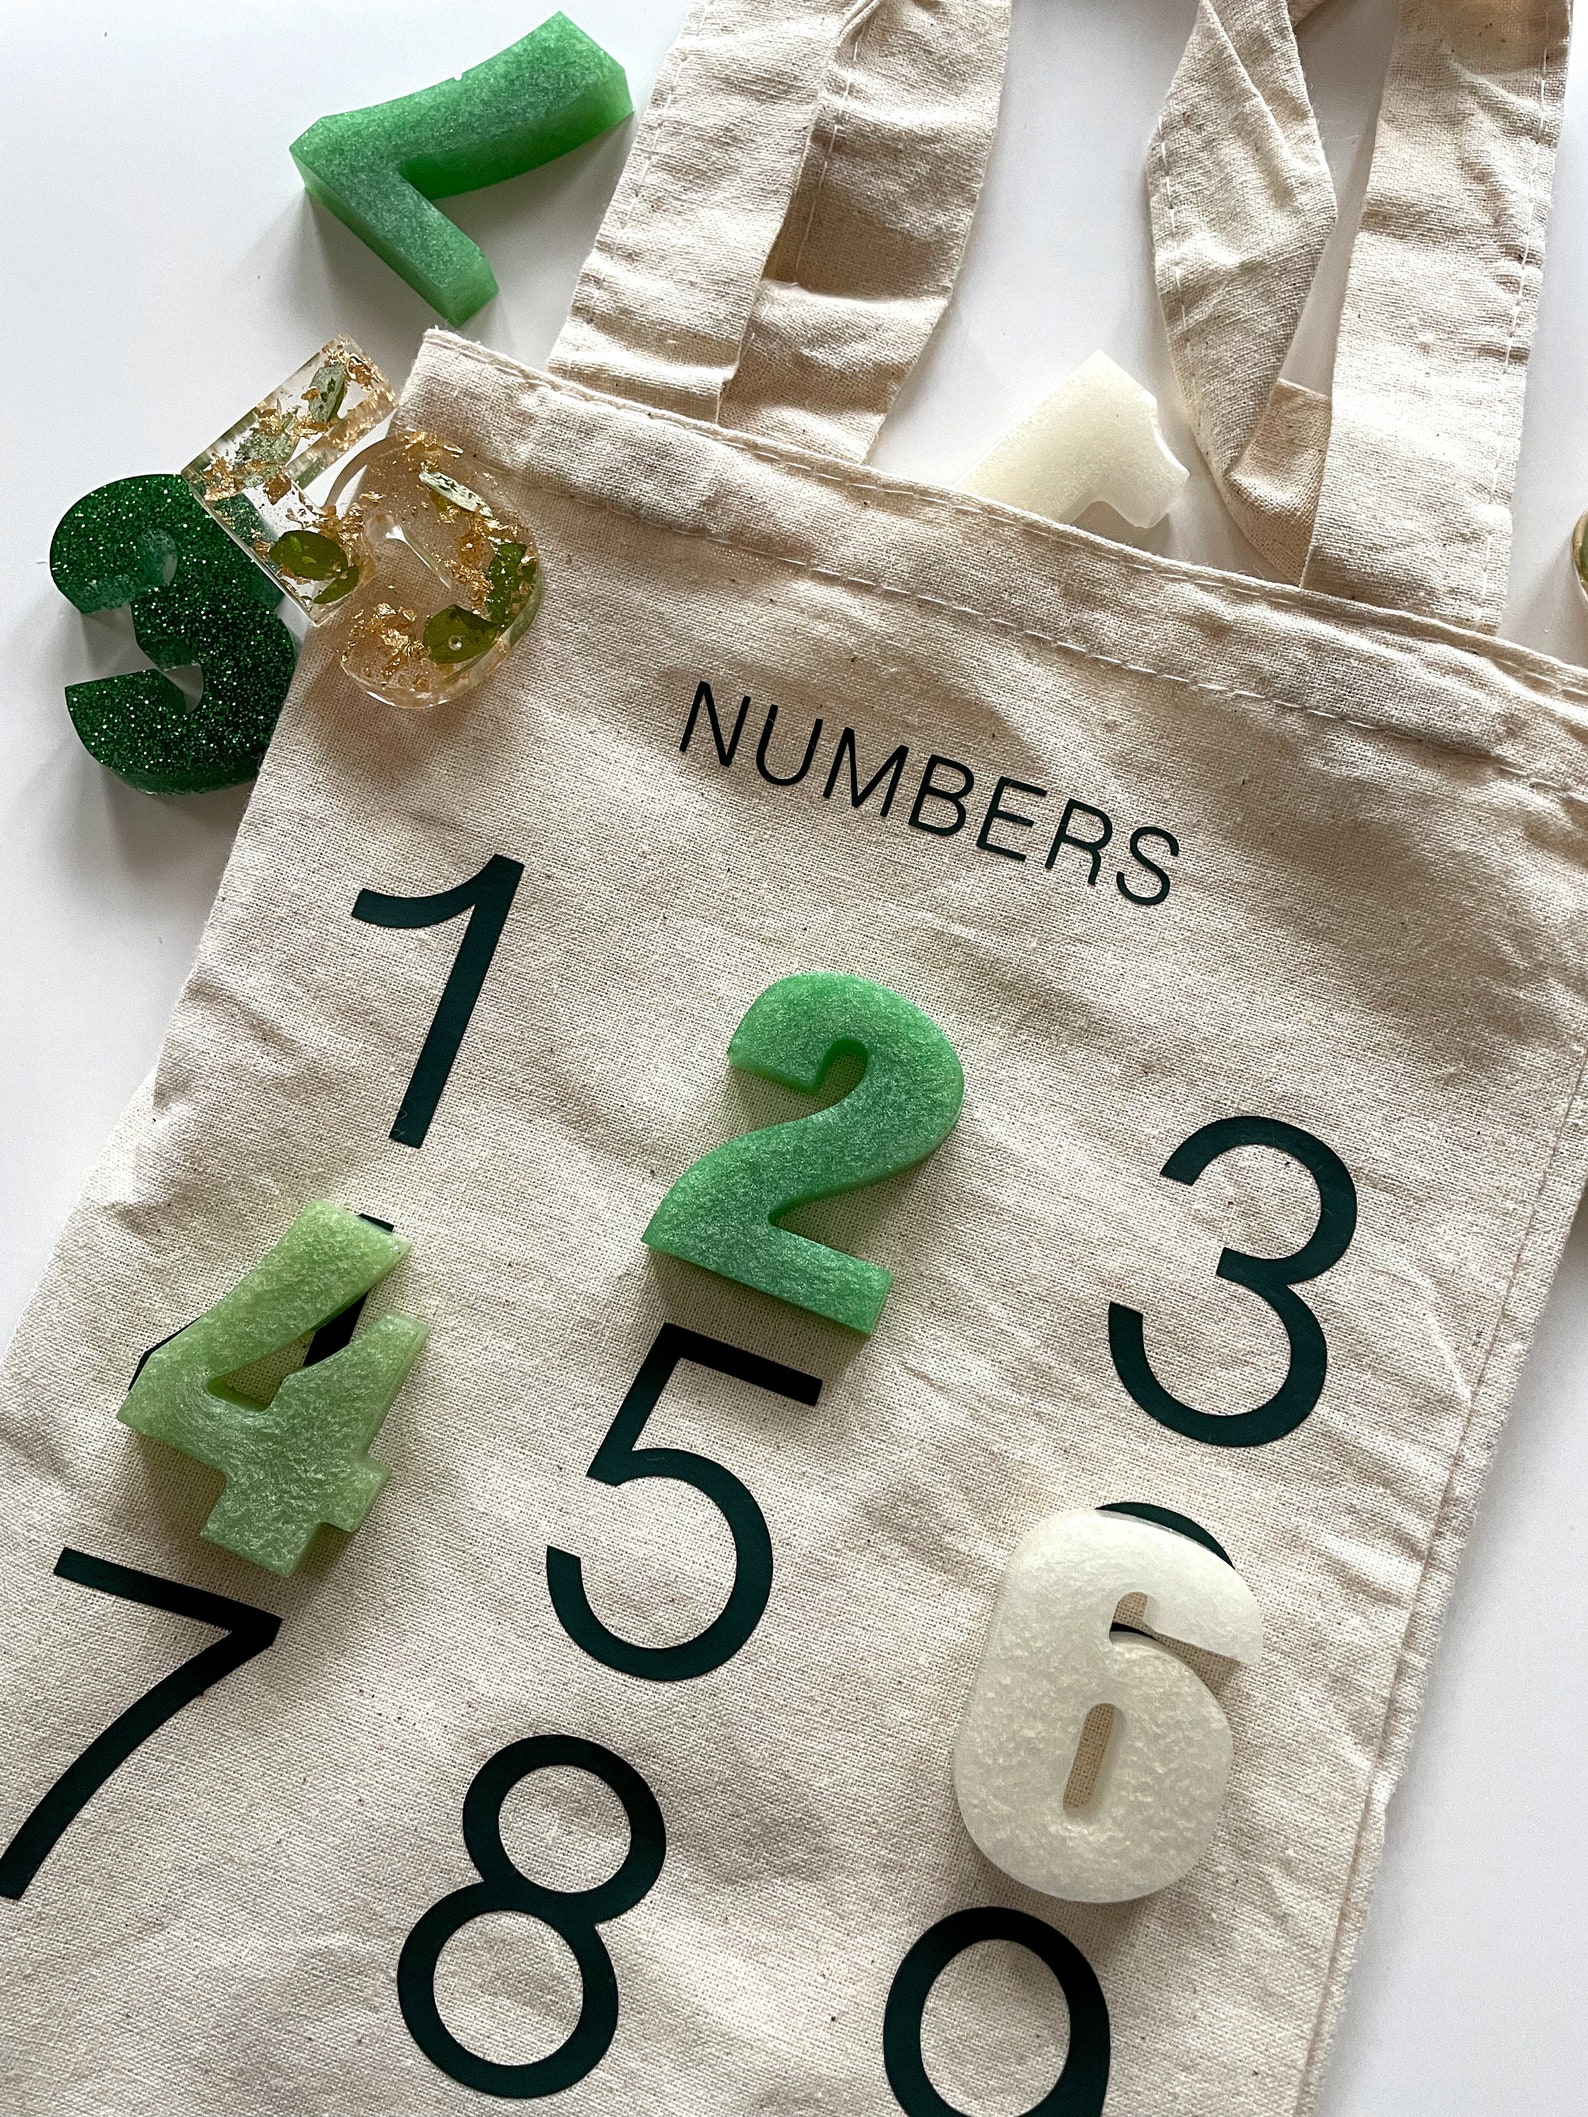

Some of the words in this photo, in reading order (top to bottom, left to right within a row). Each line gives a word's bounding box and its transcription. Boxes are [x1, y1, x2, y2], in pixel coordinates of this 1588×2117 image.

[290, 11, 633, 325] 7
[49, 473, 298, 796] 3
[678, 681, 1181, 906] NUMBERS
[350, 853, 525, 1149] 1
[641, 971, 965, 1335] 2
[117, 1199, 431, 1577] 4
[1107, 1115, 1357, 1448] 3
[546, 1322, 823, 1683] 5
[0, 1547, 284, 1901] 7
[954, 1507, 1265, 1904] 6
[397, 1734, 666, 2099] 8
